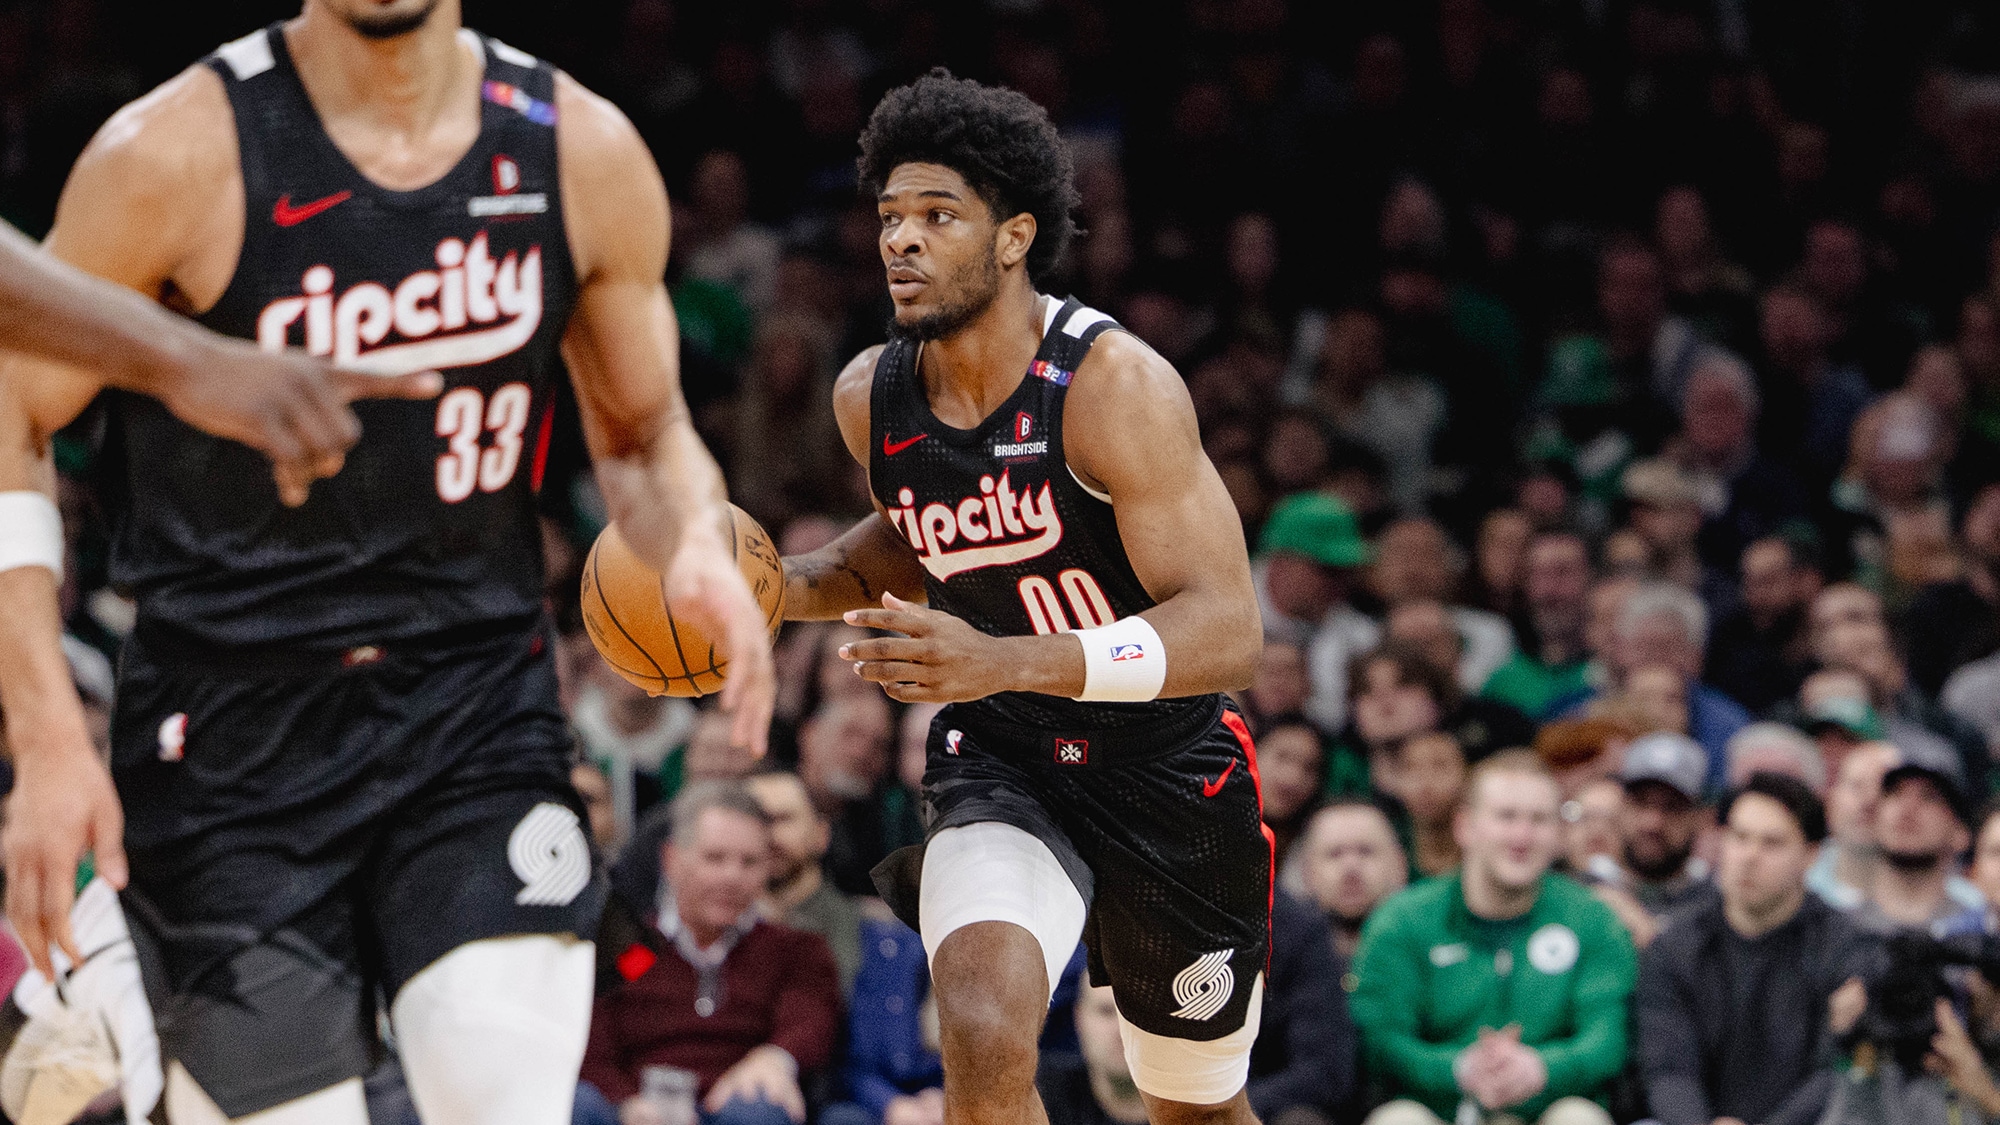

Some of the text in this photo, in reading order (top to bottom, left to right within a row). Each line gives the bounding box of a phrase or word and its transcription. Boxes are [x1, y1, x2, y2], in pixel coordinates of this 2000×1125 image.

[1043, 364, 1060, 382] 32
[435, 382, 531, 503] 33
[994, 441, 1048, 457] BRIGHTSIDE
